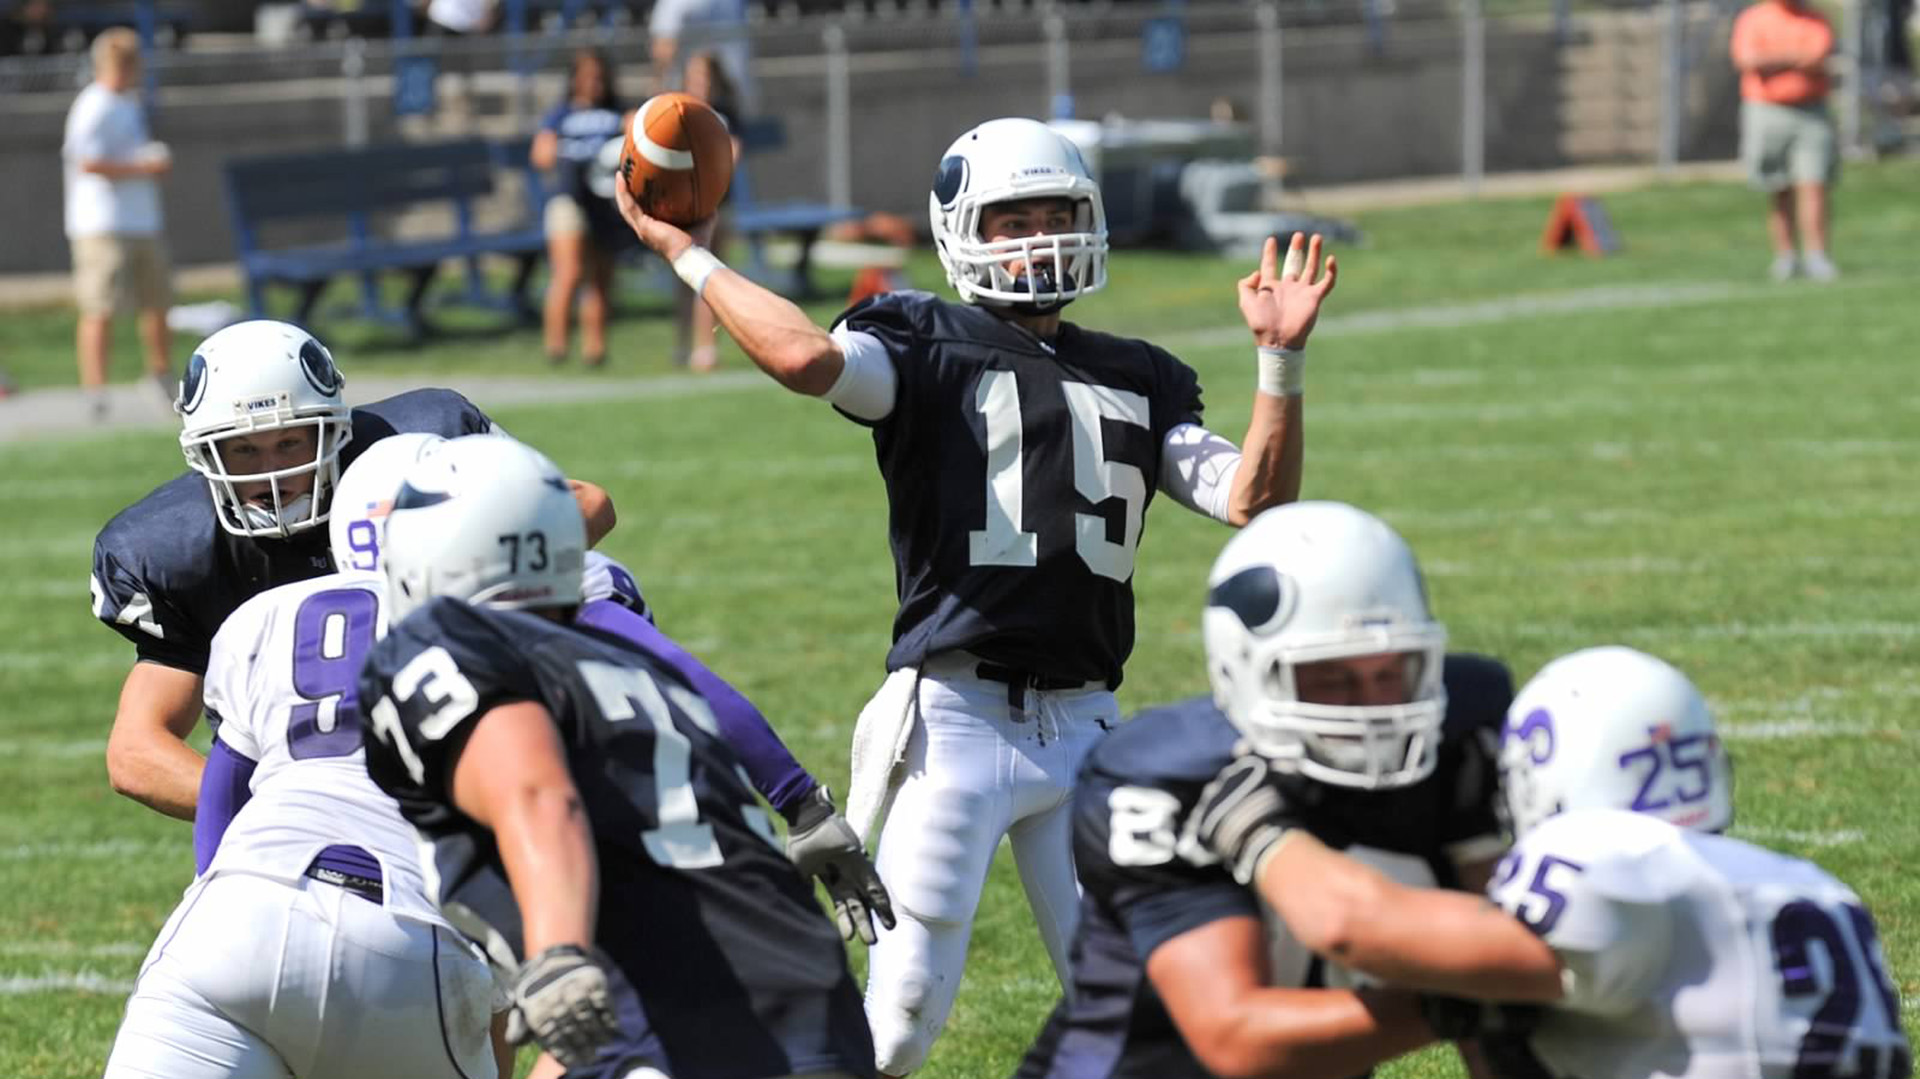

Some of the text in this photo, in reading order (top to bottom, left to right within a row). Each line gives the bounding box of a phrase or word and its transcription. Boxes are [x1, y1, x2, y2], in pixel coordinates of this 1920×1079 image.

[247, 397, 278, 411] VIKES
[969, 370, 1150, 583] 15
[498, 529, 548, 575] 73
[371, 646, 479, 787] 73
[1618, 733, 1718, 812] 25
